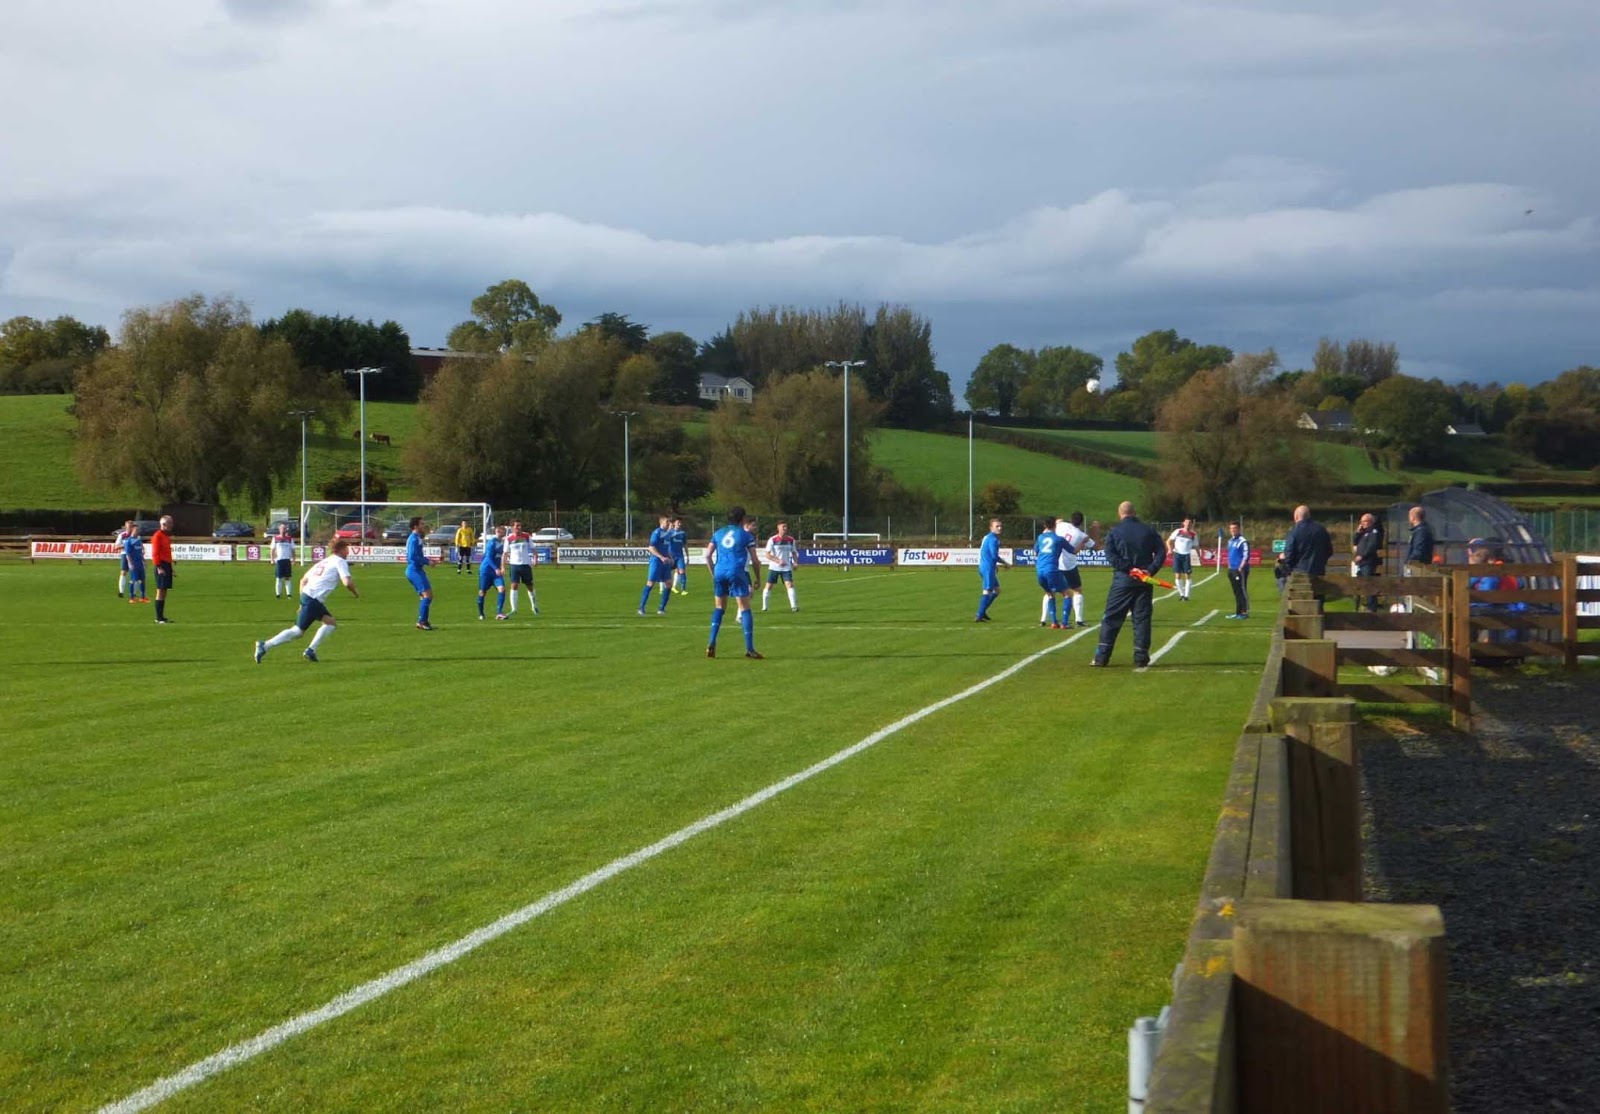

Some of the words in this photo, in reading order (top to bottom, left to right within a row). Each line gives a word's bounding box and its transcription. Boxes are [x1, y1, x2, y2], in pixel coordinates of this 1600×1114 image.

[721, 529, 736, 549] 6
[1040, 537, 1054, 553] 2
[35, 543, 66, 553] BRIAN
[903, 549, 949, 562] fastway
